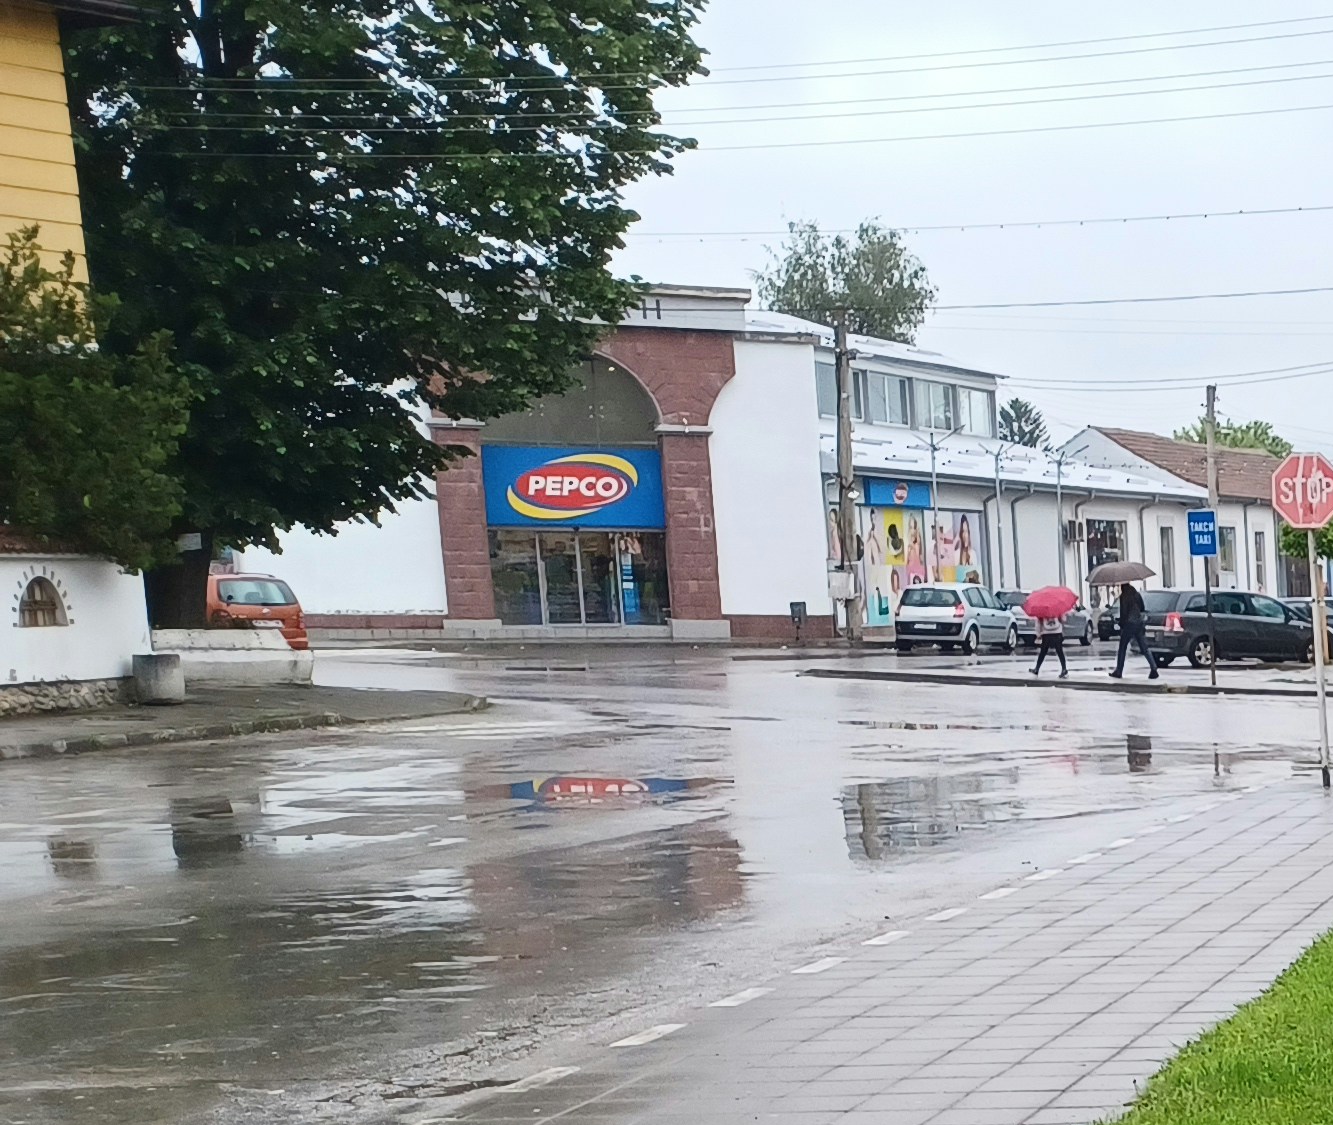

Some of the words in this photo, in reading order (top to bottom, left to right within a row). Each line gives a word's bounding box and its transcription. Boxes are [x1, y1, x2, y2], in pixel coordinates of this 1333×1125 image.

[528, 475, 619, 497] PEPCO
[1189, 521, 1214, 532] ТАКСИ
[1194, 534, 1212, 545] TAXI
